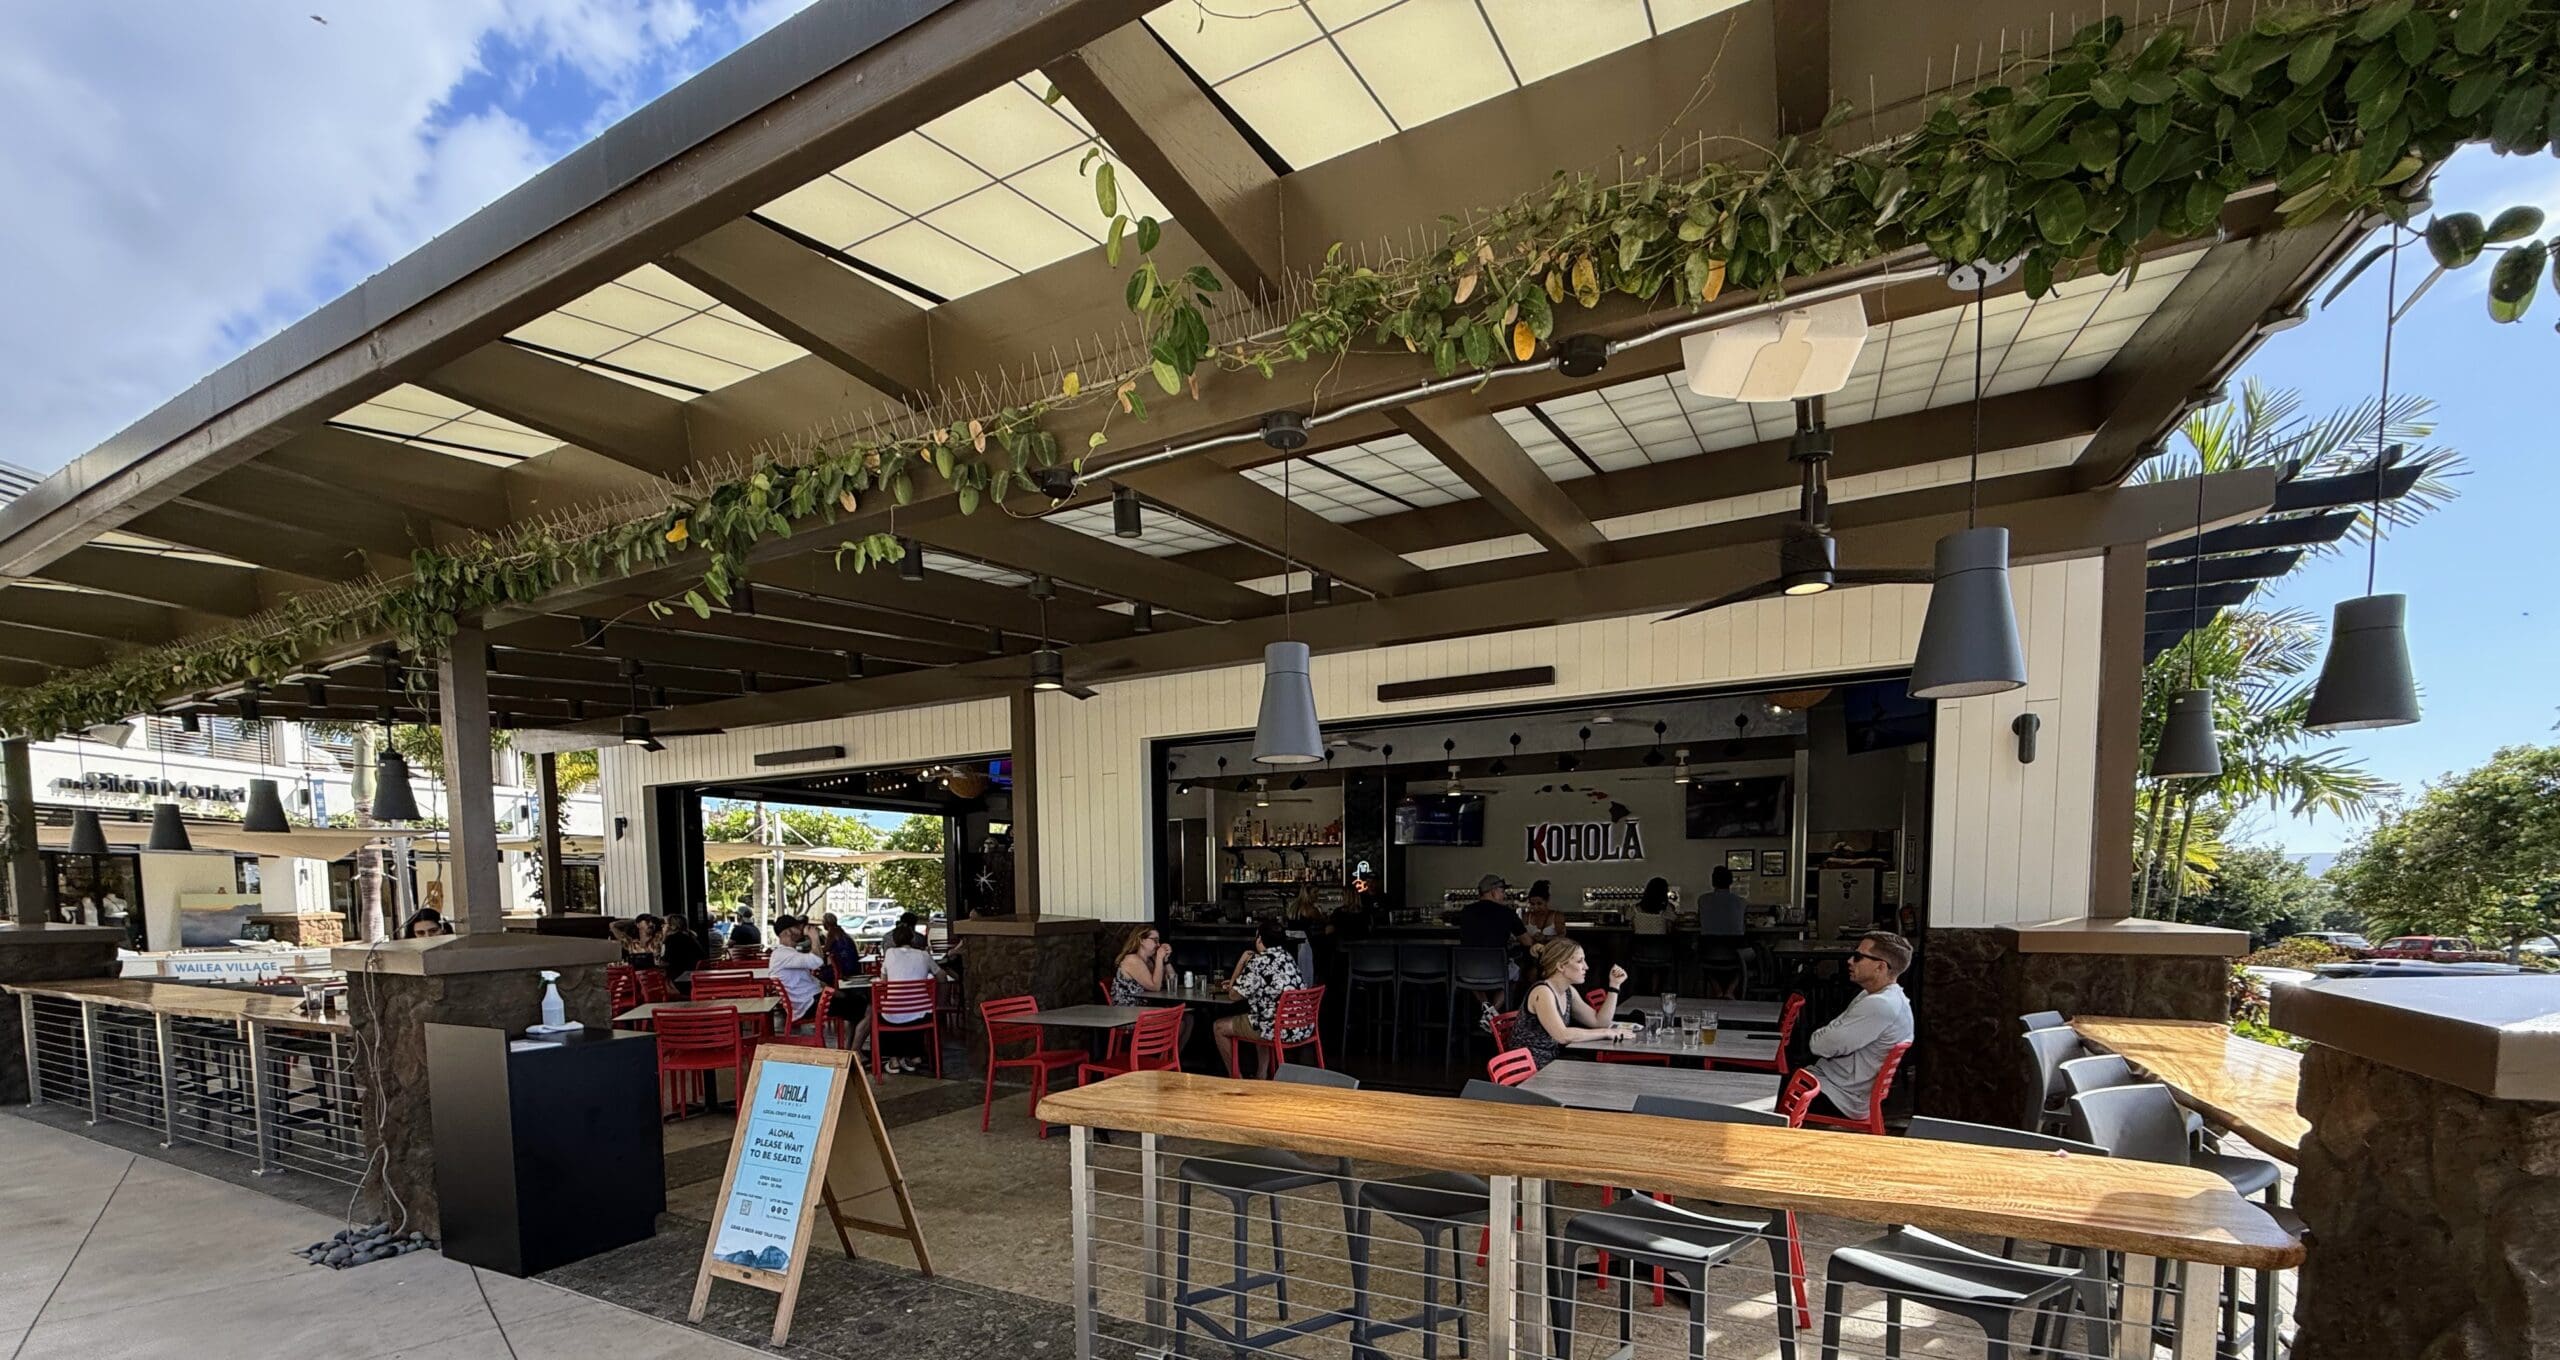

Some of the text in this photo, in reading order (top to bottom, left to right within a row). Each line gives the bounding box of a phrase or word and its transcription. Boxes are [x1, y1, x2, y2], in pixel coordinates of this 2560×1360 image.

[160, 778, 247, 803] Market
[174, 961, 279, 973] WAILEA VILLAGE
[767, 1127, 795, 1140] ALOHA,
[754, 1137, 805, 1153] PLEASE WAIT
[750, 1148, 803, 1165] TO BE SEATED.
